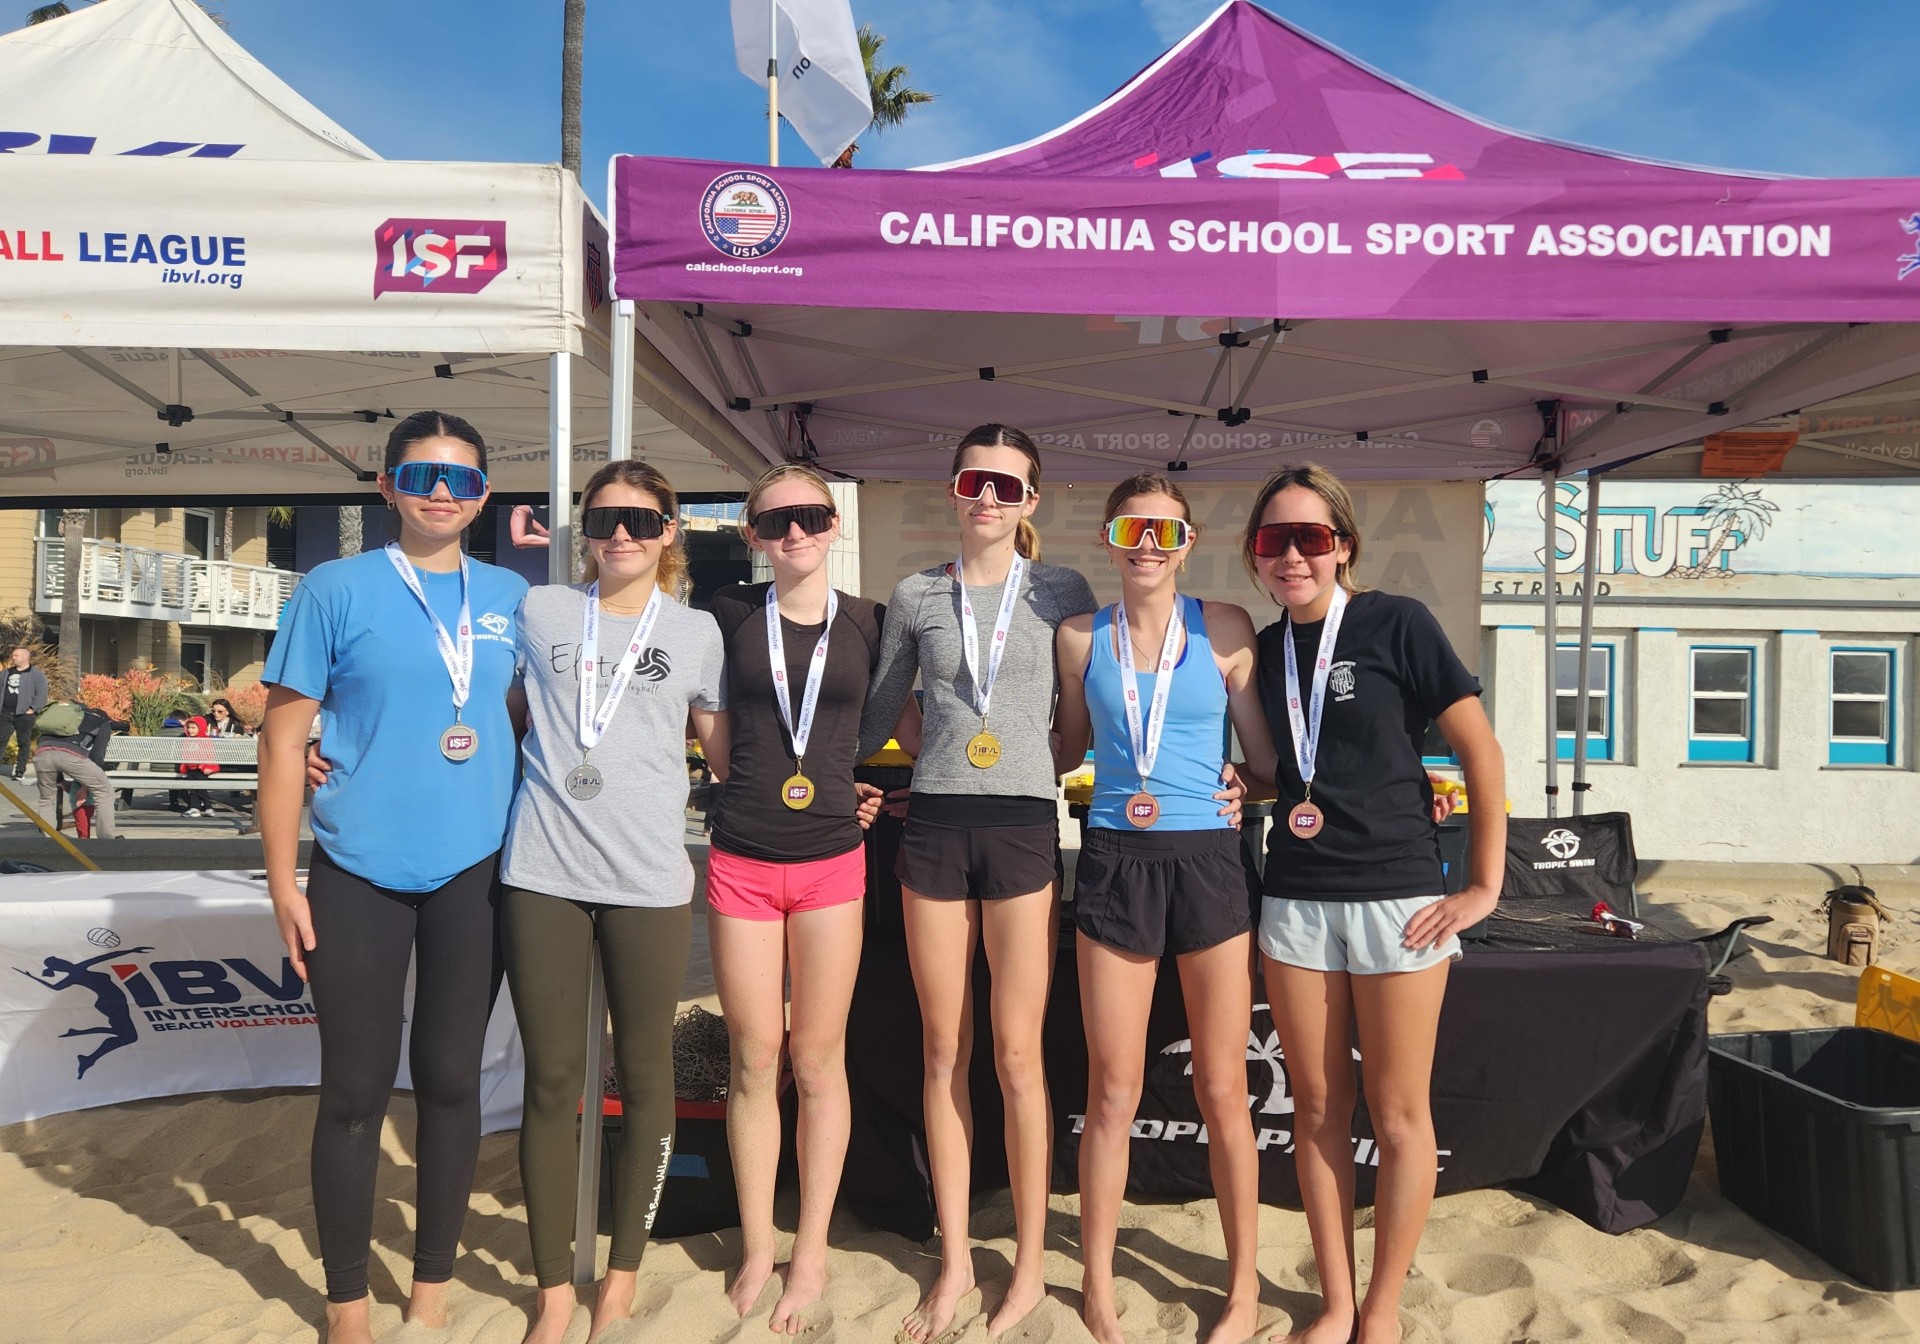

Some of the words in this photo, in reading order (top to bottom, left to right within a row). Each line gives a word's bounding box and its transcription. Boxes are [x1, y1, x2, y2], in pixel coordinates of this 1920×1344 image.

[704, 190, 717, 235] CALIFORNIA
[715, 174, 745, 192] SCHOOL
[746, 174, 772, 189] SPORT
[770, 187, 787, 237] ASSOCIATION
[880, 211, 1155, 252] CALIFORNIA
[1168, 219, 1352, 255] SCHOOL
[1365, 222, 1515, 256] SPORT
[1526, 223, 1831, 257] ASSOCIATION
[79, 232, 247, 267] LEAGUE
[391, 233, 492, 279] ISF
[732, 246, 760, 257] USA
[685, 262, 803, 276] calschoolsport.org
[162, 268, 243, 290] ibvl.org
[449, 737, 470, 749] ISF
[789, 787, 807, 798] ISF
[1134, 805, 1152, 816] ISF
[1297, 816, 1316, 827] ISF
[1533, 860, 1568, 870] TROPIC
[1569, 858, 1596, 868] SWIM
[152, 1019, 215, 1032] BEACH
[648, 1181, 664, 1211] Beach
[656, 1133, 672, 1183] Volleyball
